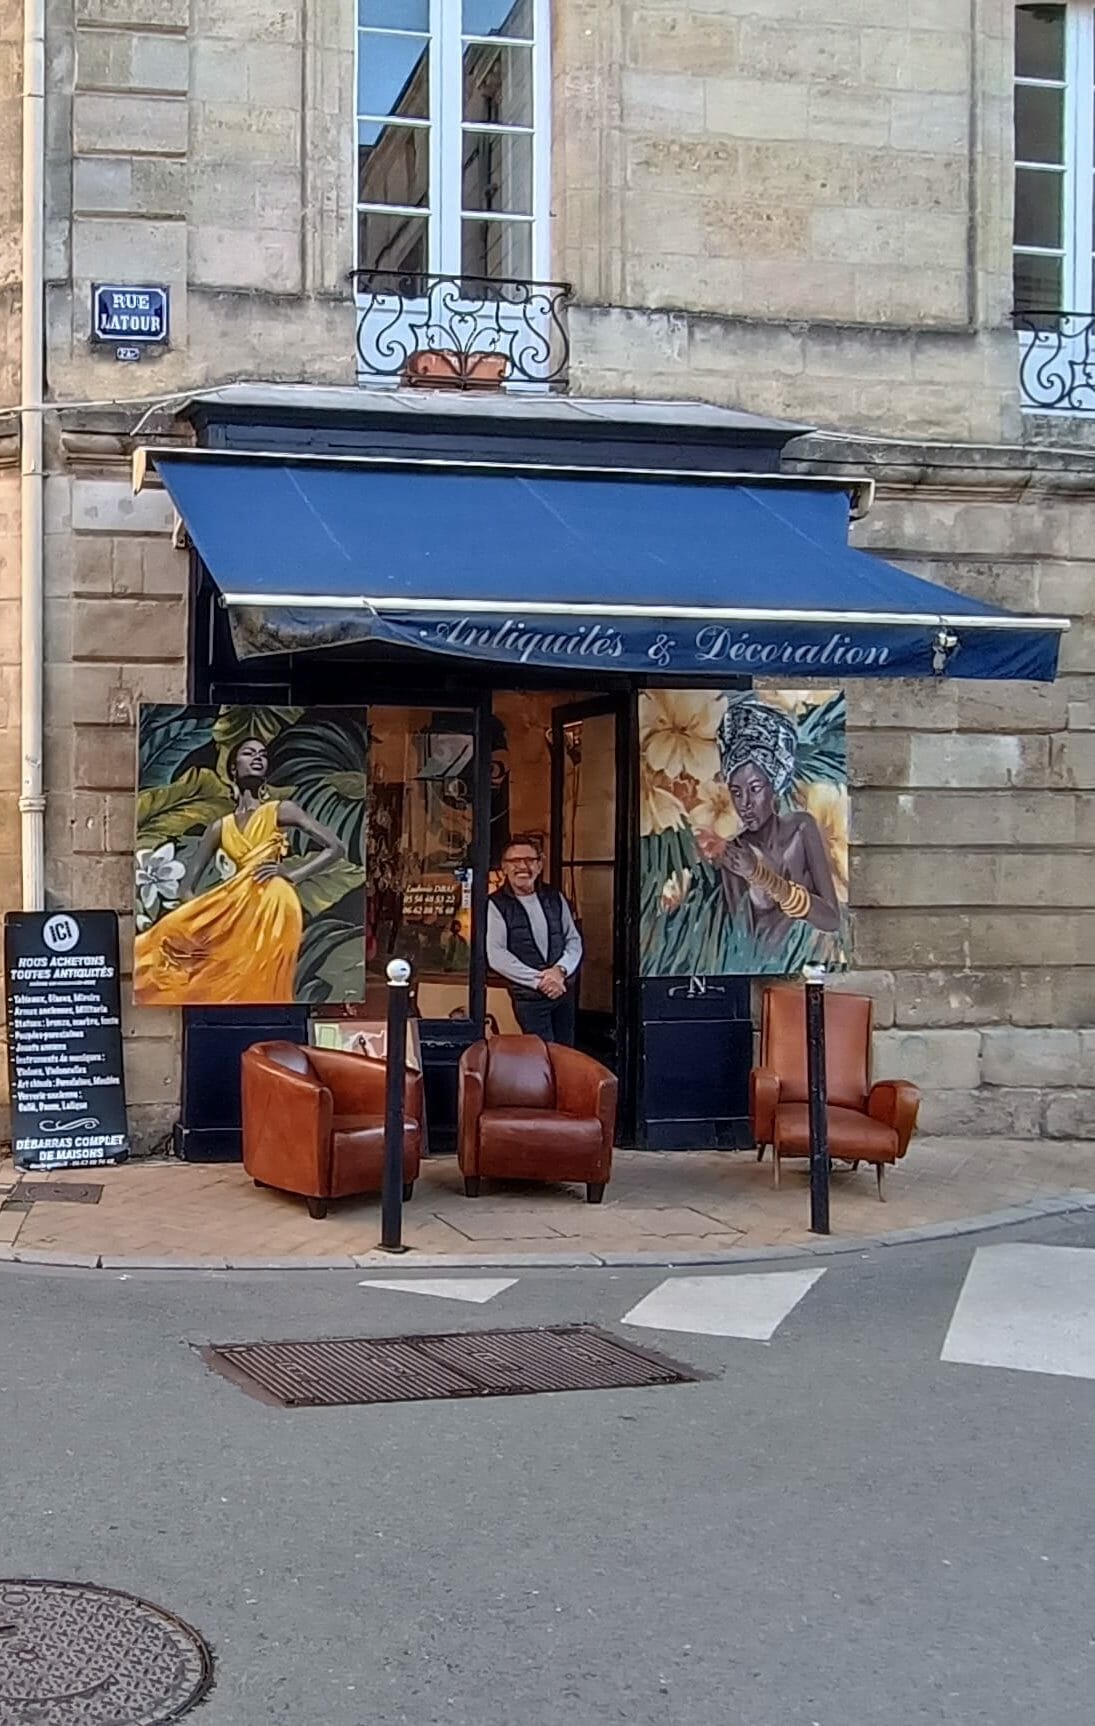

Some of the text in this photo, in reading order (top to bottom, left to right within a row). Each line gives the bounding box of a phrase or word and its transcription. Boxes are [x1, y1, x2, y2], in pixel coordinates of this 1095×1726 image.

[112, 293, 150, 310] RUE
[100, 313, 161, 332] LATOUR
[423, 617, 892, 667] Antiquités & Décoration
[48, 920, 73, 944] ICI
[18, 955, 105, 968] NOUS ACHETONS
[10, 966, 115, 980] TOUTES ANTIQUITÉS
[16, 1134, 125, 1150] DÉBARRAS COMPLET
[39, 1148, 104, 1161] DE MAISONS
